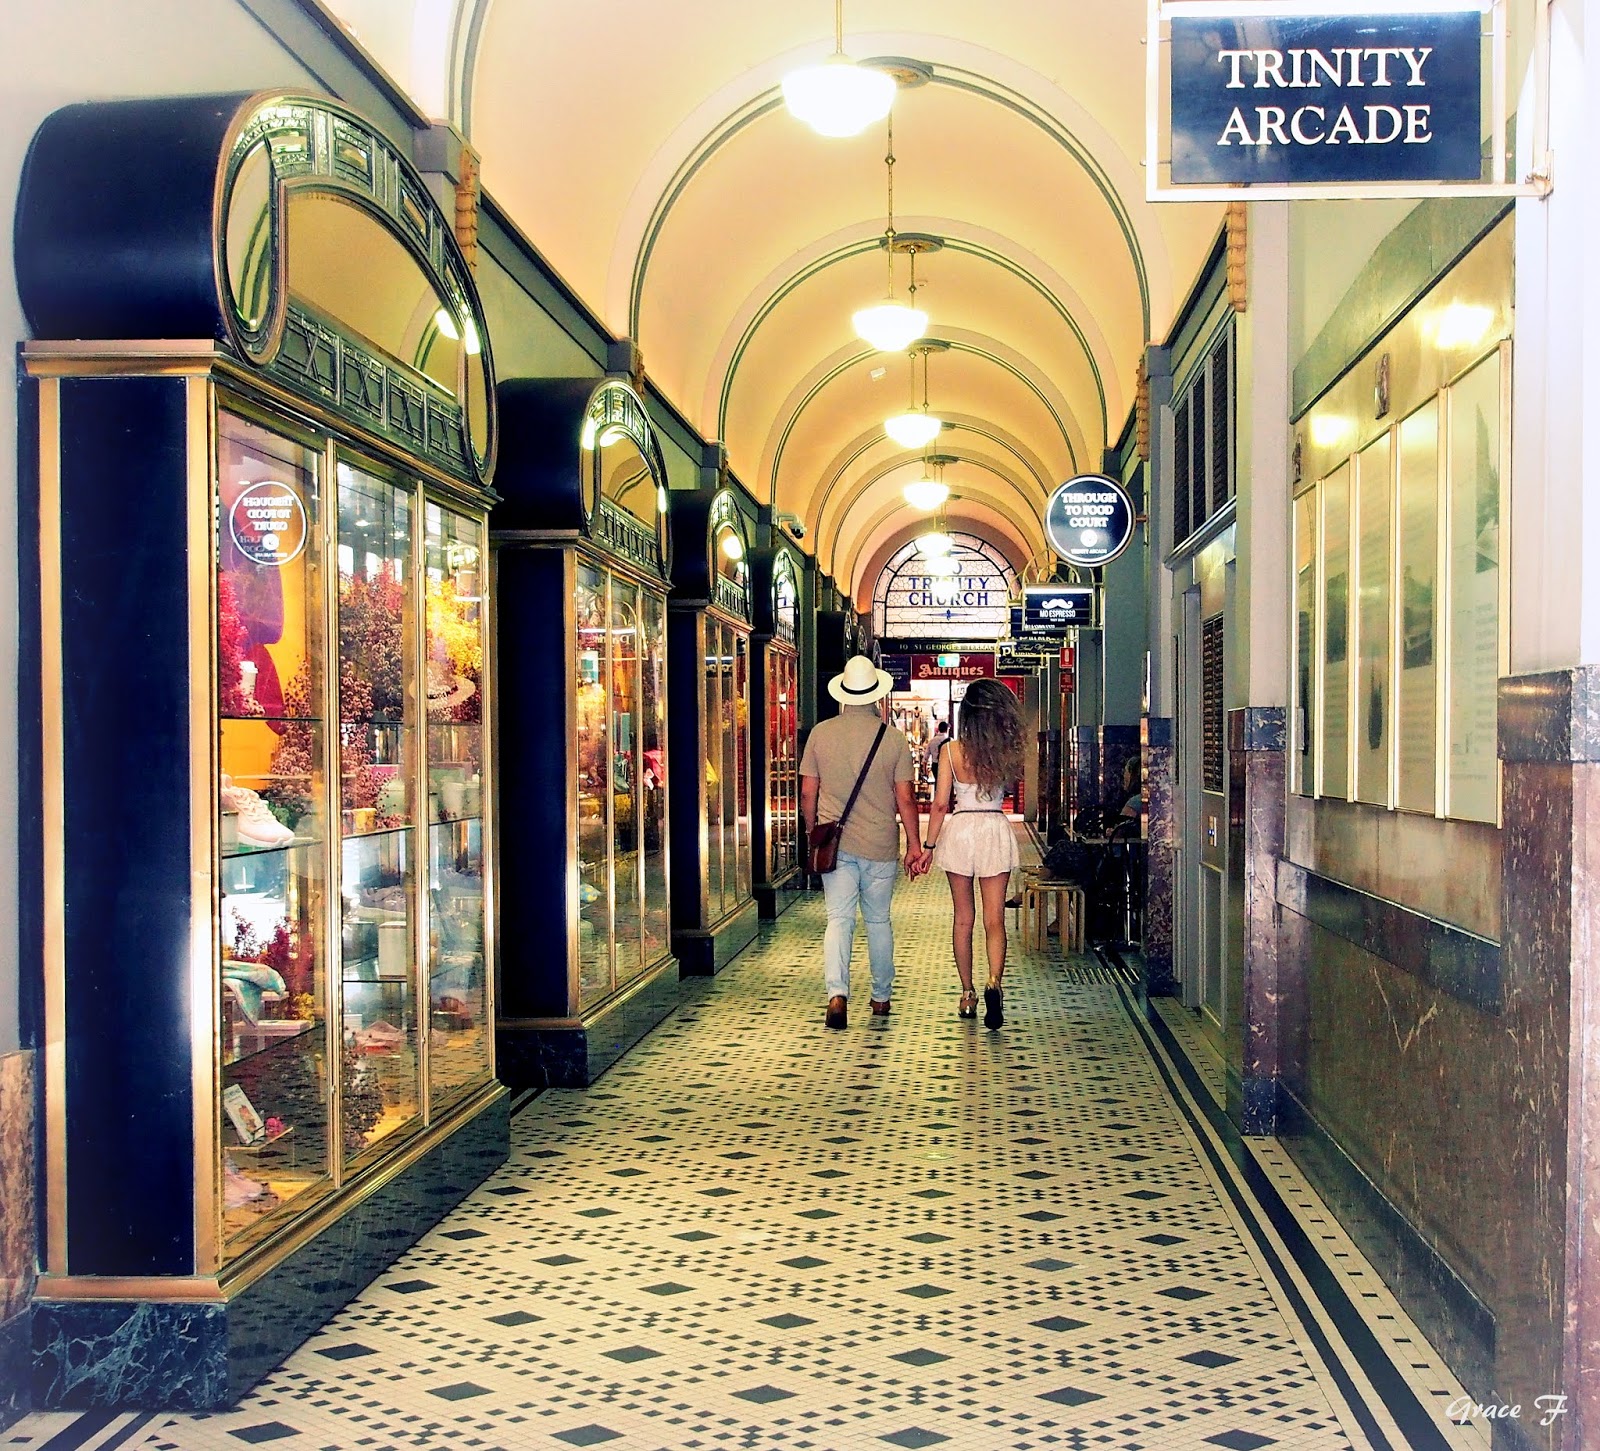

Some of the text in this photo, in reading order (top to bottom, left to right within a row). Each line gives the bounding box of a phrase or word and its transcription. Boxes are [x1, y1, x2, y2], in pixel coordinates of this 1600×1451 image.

[1218, 47, 1432, 88] TRINITY
[1217, 105, 1432, 146] ARCADE
[1061, 493, 1117, 503] THROUGH
[1065, 505, 1114, 515] TO FOOD
[1069, 517, 1109, 528] COURT
[908, 577, 990, 590] TRITY
[1049, 609, 1076, 617] ESPRESSO
[918, 664, 984, 678] Antiques
